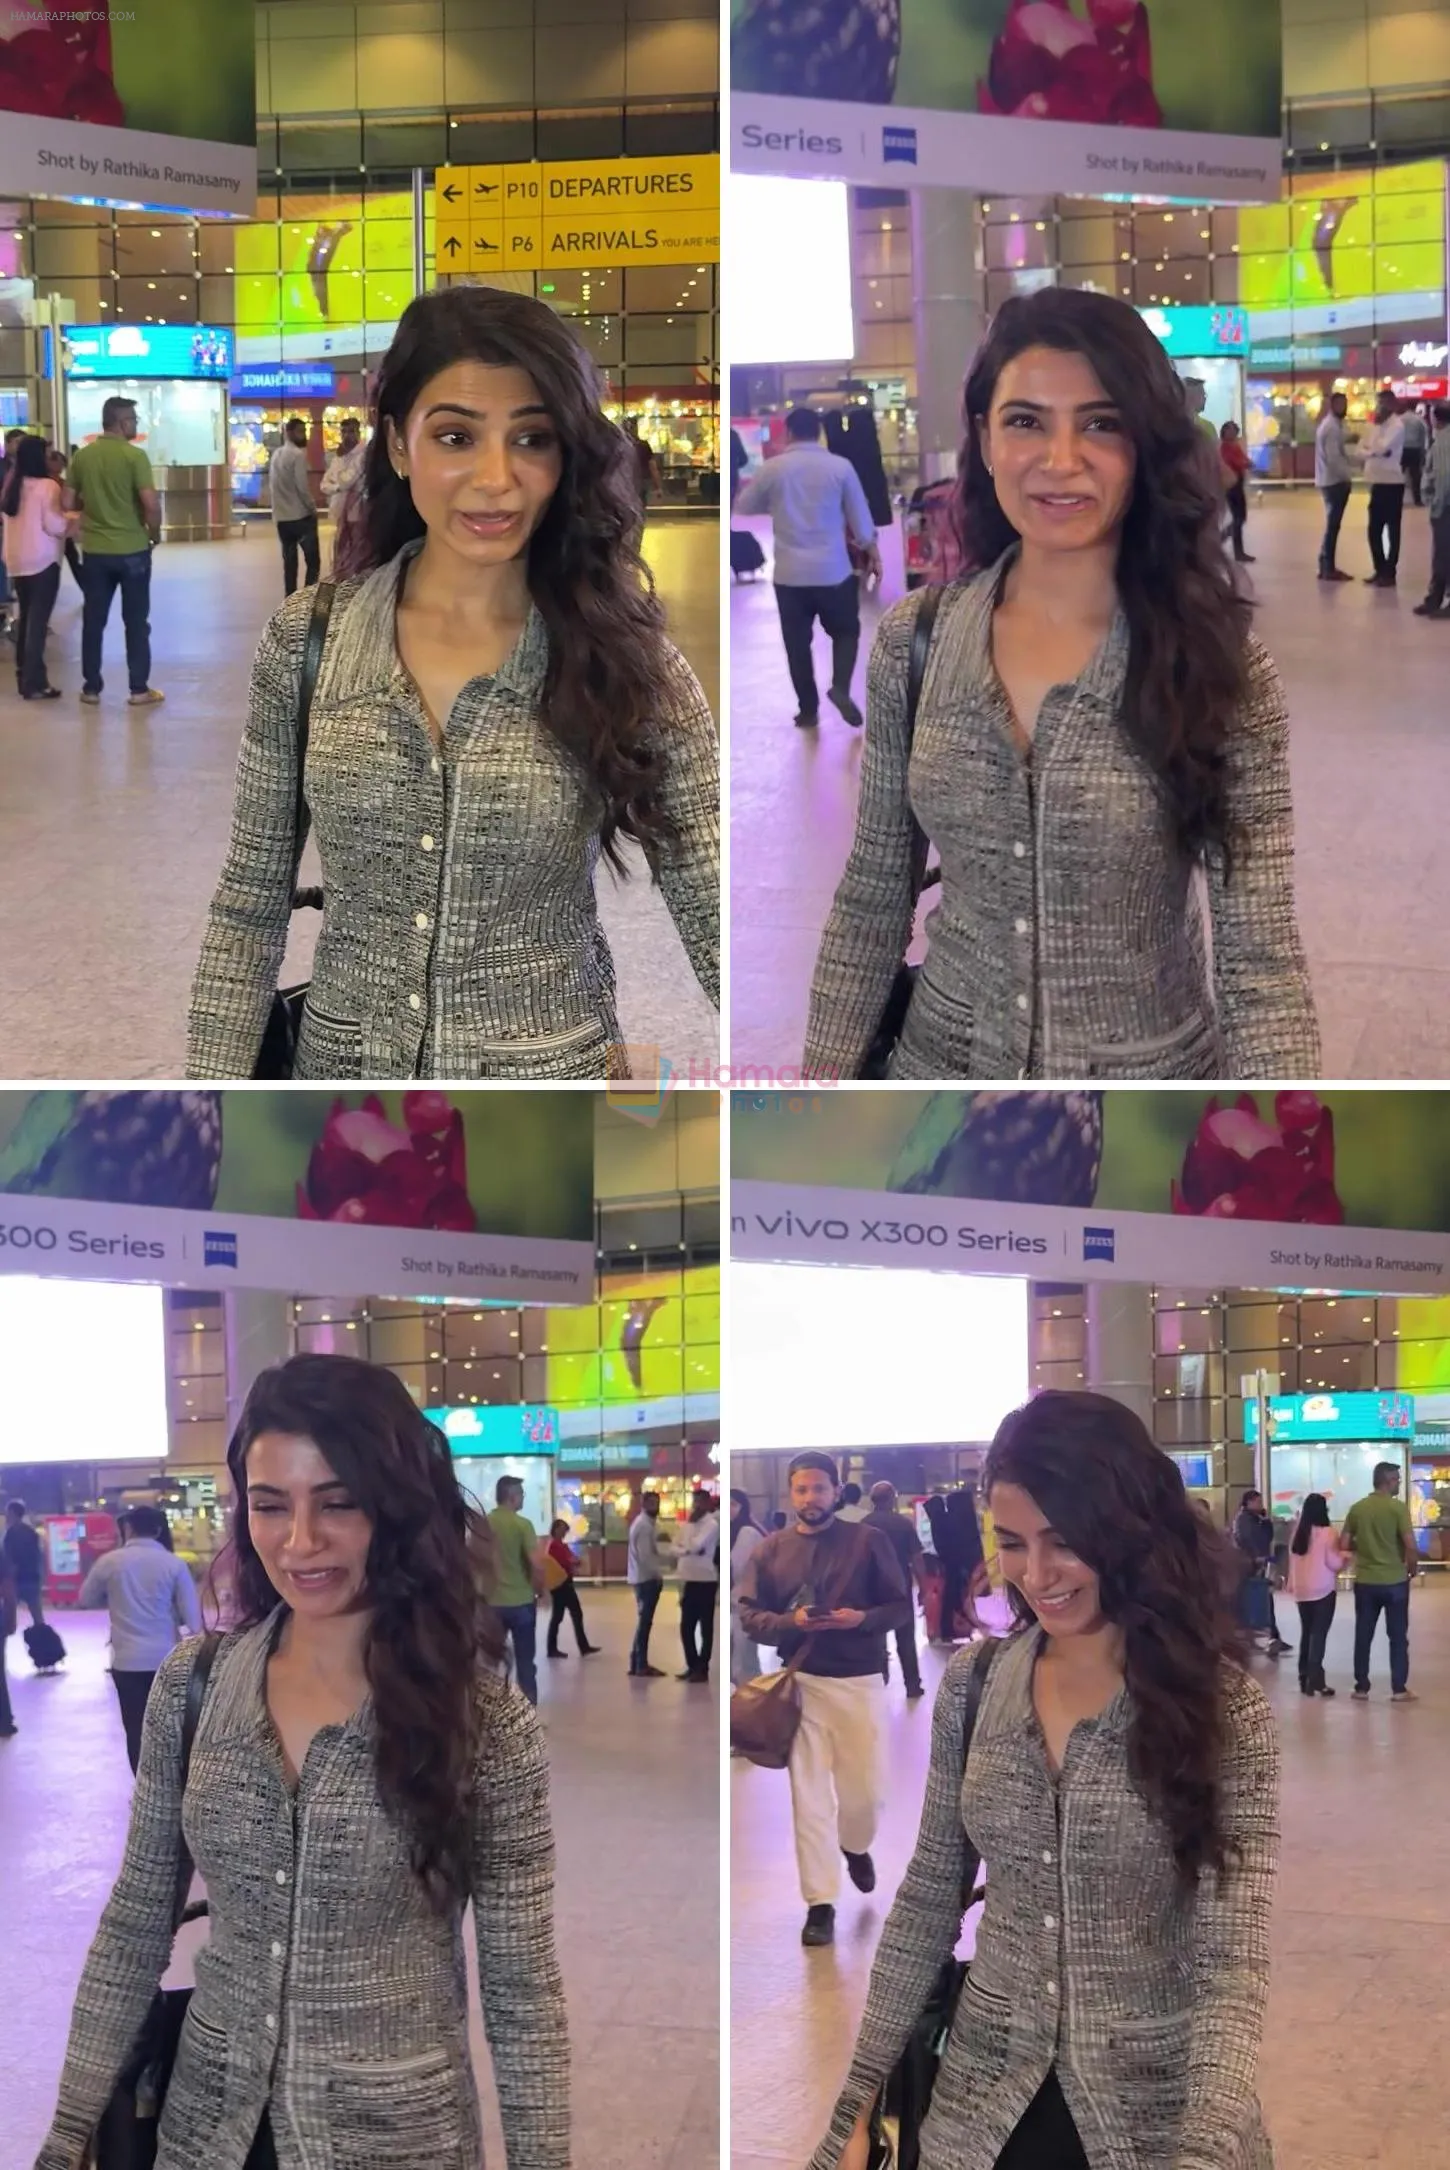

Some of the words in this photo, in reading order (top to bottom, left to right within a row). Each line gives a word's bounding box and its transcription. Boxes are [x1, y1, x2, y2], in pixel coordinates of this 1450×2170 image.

[741, 124, 843, 155] Series
[37, 149, 75, 170] Shot
[79, 155, 99, 176] by
[103, 157, 160, 180] Rathika
[164, 166, 241, 193] Ramasamy
[1086, 152, 1119, 170] Shot
[1122, 156, 1138, 175] by
[507, 182, 538, 199] P10
[549, 173, 693, 199] DEPARTURES
[512, 236, 533, 252] P6
[551, 229, 659, 253] ARRIVALS
[661, 238, 680, 248] YOU
[683, 237, 702, 247] ARE
[68, 1230, 165, 1259] Series
[755, 1210, 849, 1239] vivo
[860, 1220, 948, 1247] X300
[958, 1227, 1048, 1254] Series
[401, 1257, 432, 1273] Shot
[437, 1260, 453, 1277] by
[457, 1261, 508, 1278] Rathika
[510, 1265, 579, 1284] Ramasamy
[1270, 1250, 1301, 1266] Shot
[1304, 1252, 1321, 1269] by
[1324, 1253, 1372, 1269] Rathika
[1376, 1256, 1444, 1275] Ramasamy
